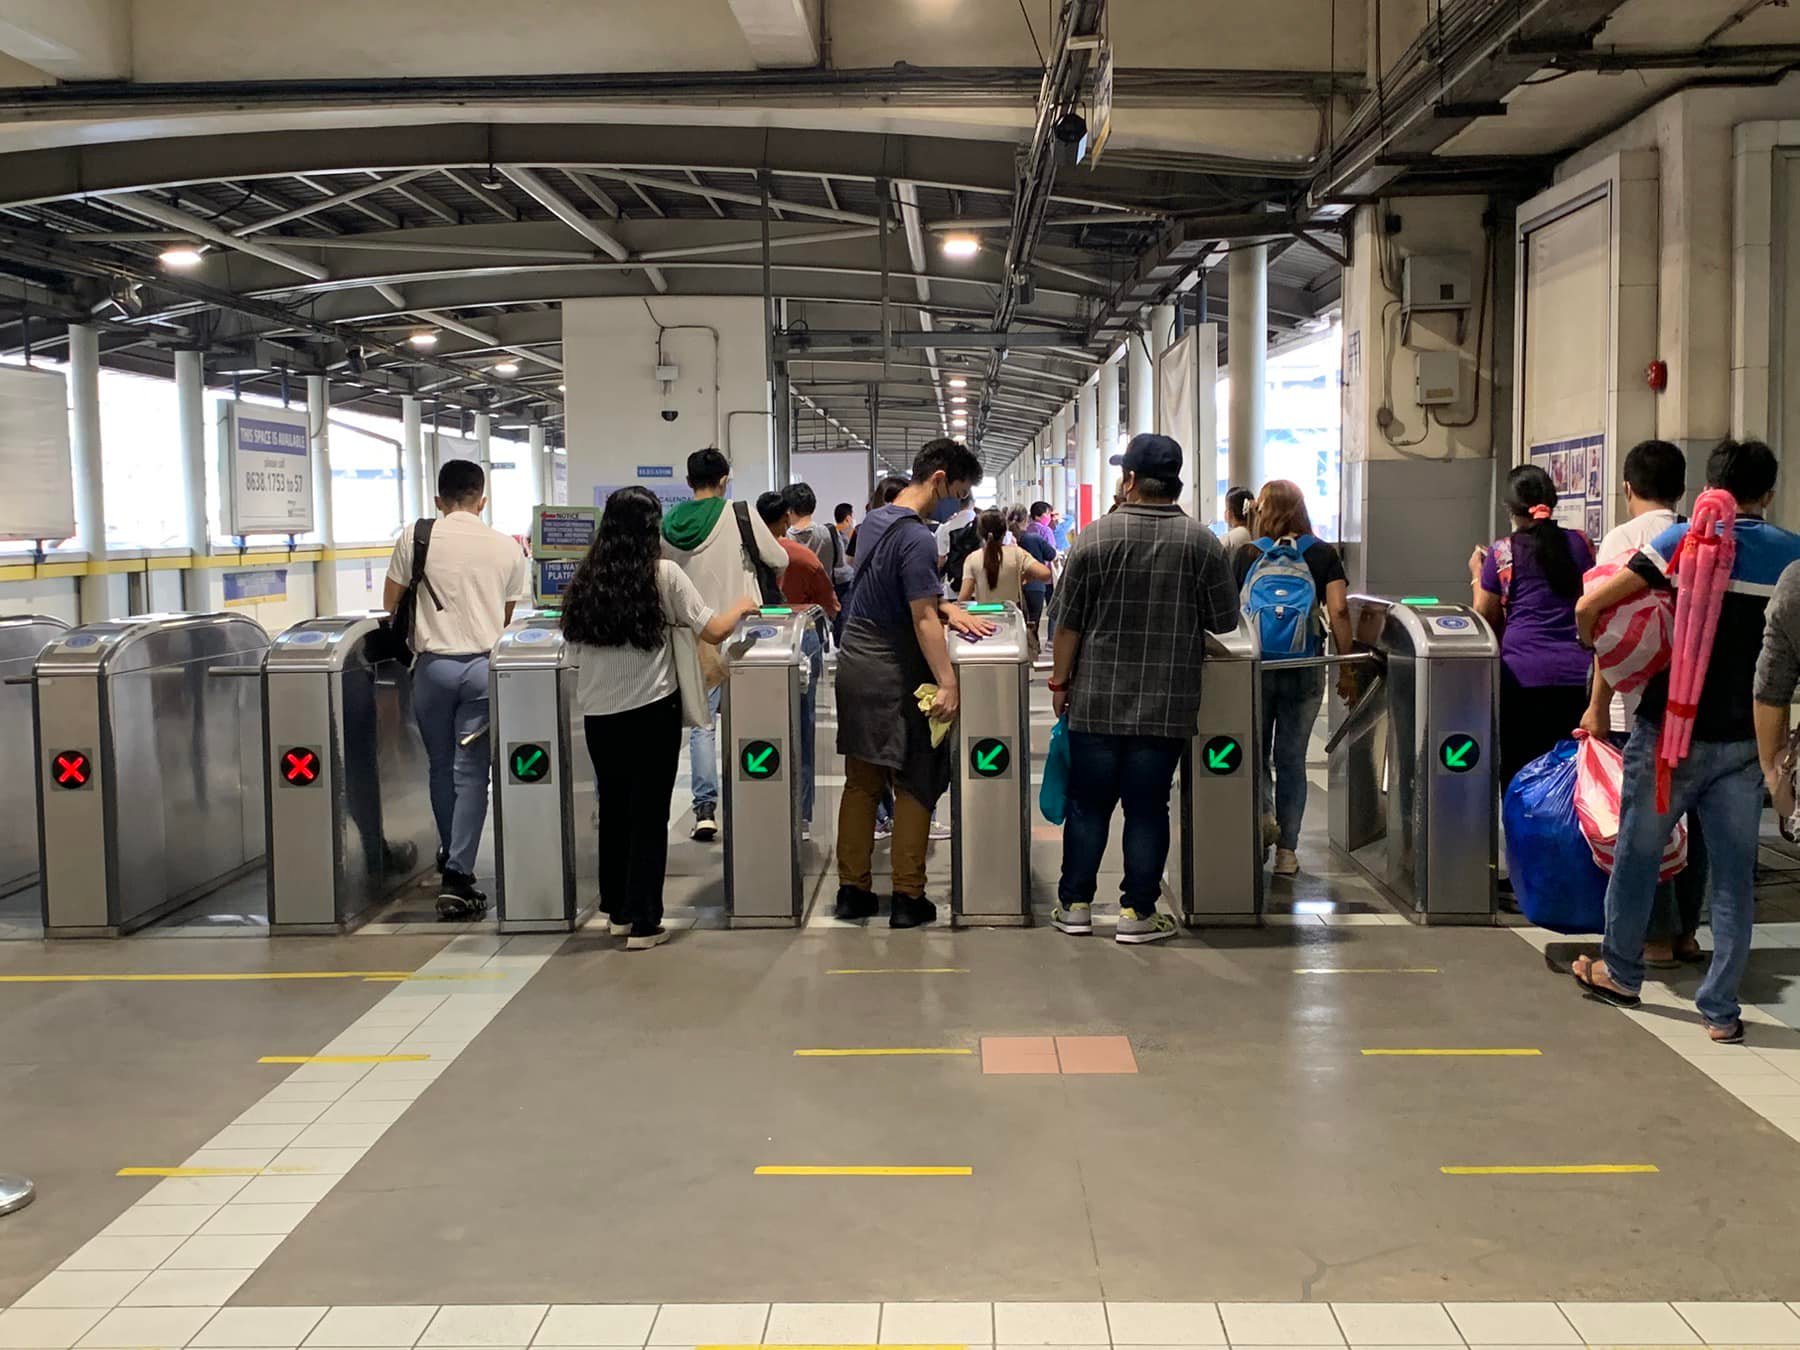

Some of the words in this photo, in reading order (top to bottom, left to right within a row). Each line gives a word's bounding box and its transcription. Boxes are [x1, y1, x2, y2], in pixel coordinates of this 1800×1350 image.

[240, 427, 253, 443] THIS
[254, 429, 271, 445] SPACE
[278, 431, 305, 449] AVAILABLE
[246, 472, 285, 492] 8638.1753
[294, 474, 303, 493] 57
[557, 512, 579, 520] NOTICE
[545, 562, 561, 572] THIS
